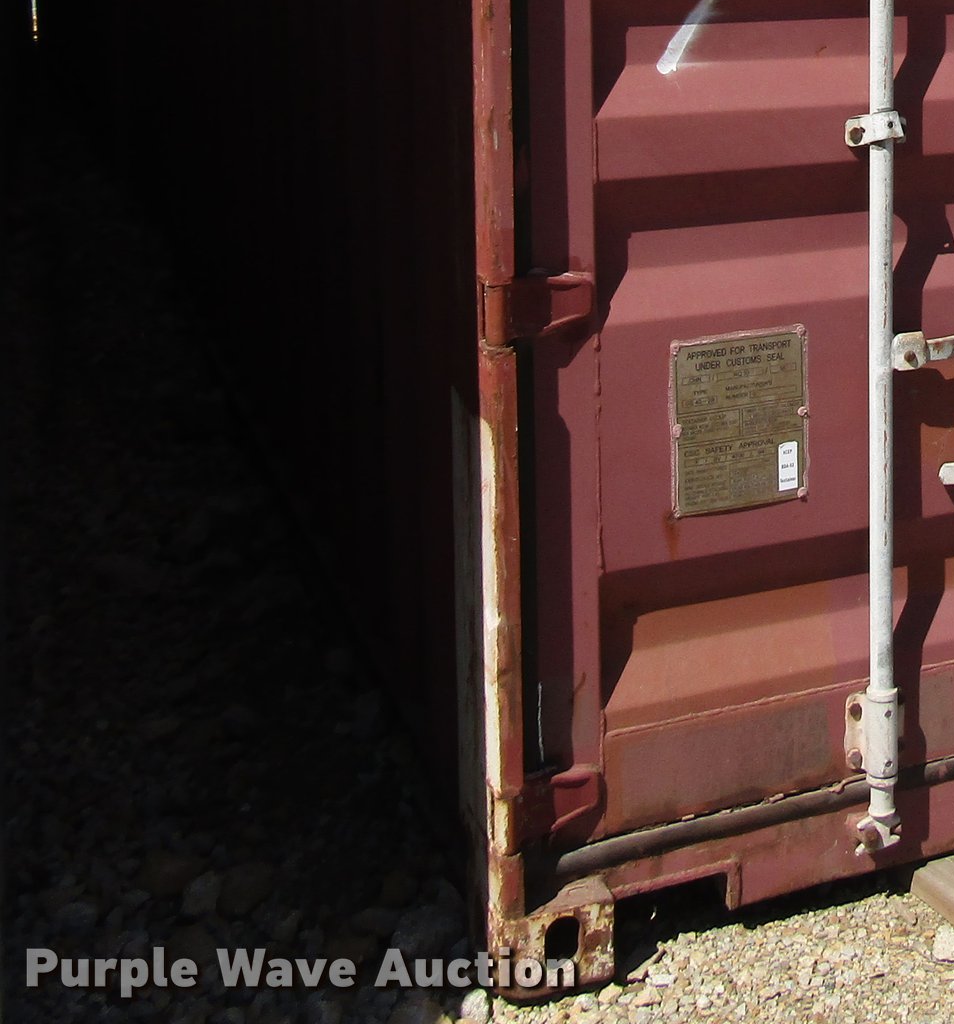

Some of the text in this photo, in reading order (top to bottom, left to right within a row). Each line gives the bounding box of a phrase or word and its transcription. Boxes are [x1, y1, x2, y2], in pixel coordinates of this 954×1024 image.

[687, 339, 792, 360] APPROVED FOR TRANSPORT
[695, 352, 785, 371] UNDER CUSTOMS SEAL
